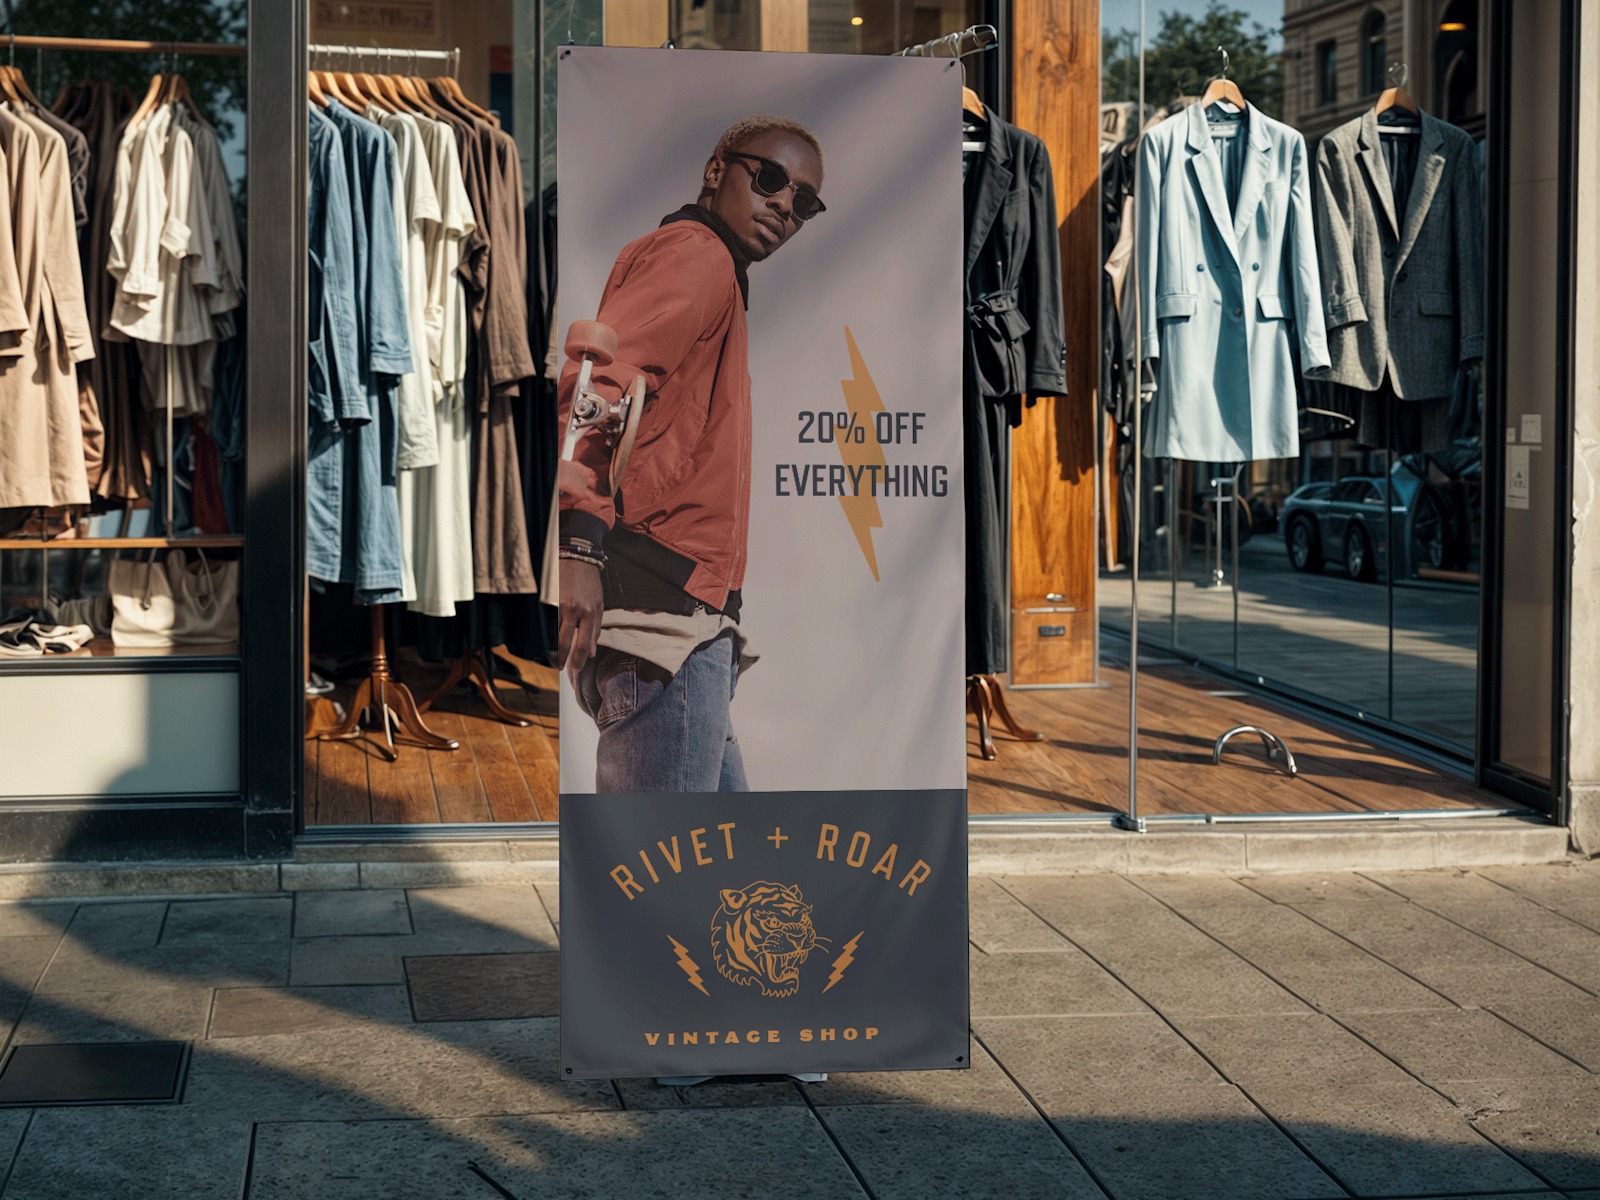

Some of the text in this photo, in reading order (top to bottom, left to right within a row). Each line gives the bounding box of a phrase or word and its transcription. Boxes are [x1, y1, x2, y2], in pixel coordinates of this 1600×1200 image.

[798, 411, 926, 444] 20% OFF
[775, 464, 948, 498] EVERYTHING
[609, 822, 932, 901] RIVET + ROAR
[645, 1027, 880, 1046] VINTAGE SHOP
